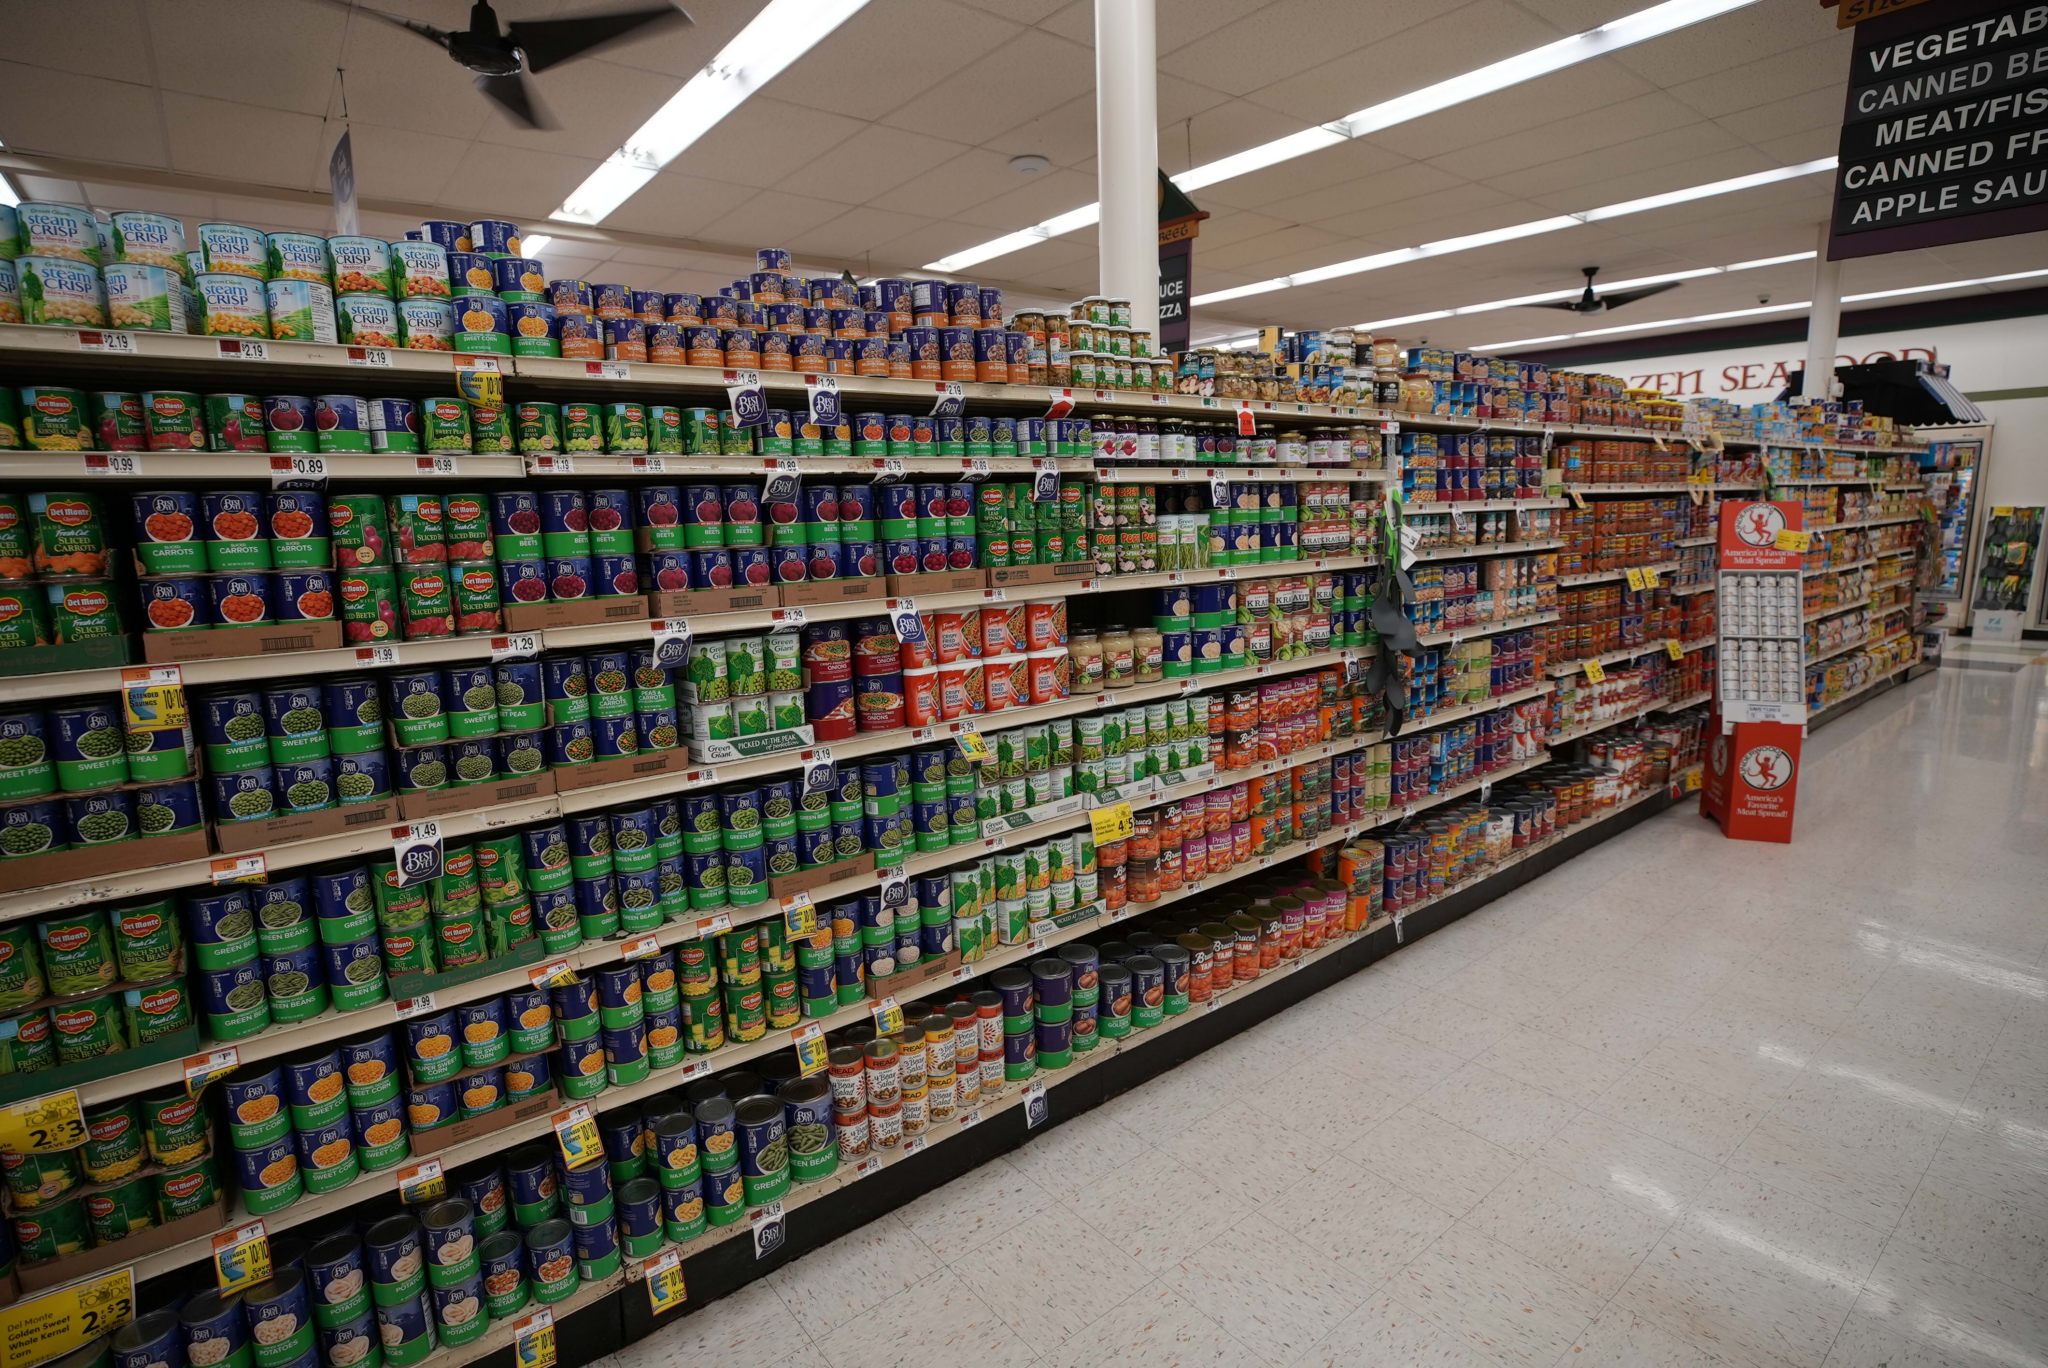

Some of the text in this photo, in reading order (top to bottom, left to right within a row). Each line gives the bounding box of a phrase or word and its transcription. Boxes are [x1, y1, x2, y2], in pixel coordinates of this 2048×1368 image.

[1858, 61, 1993, 113] CANNED
[1845, 141, 1993, 189] CANNED
[1851, 170, 2047, 224] APPLE SAU
[28, 213, 77, 228] steam
[30, 224, 78, 238] CRISP
[121, 221, 168, 234] steam
[124, 231, 168, 244] CRISP
[207, 233, 249, 246] steam
[209, 243, 249, 254] CRISP
[283, 253, 322, 264] CRISP
[104, 332, 128, 349] $2.19
[241, 343, 263, 357] $2.19
[367, 351, 386, 363] $2.19
[738, 373, 758, 385] $1.49
[818, 378, 835, 388] $1.29
[109, 458, 133, 472] $0.99
[293, 459, 322, 474] $0.89
[434, 458, 452, 472] $0.99
[553, 459, 569, 471] $1.19
[778, 460, 797, 472] $0.89
[885, 460, 901, 471] $0.79
[971, 460, 988, 471] $0.89
[58, 537, 91, 545] SLICED
[152, 548, 194, 557] CARROTS
[219, 546, 259, 554] CARROTS
[276, 544, 312, 553] CARROTS
[1755, 557, 1786, 565] Spread!
[431, 606, 448, 614] BEETS
[897, 600, 914, 610] $1.29
[75, 626, 107, 634] SLICED
[666, 621, 687, 633] $1.29
[509, 637, 534, 650] $1.29
[774, 644, 794, 652] Giant
[374, 648, 392, 661] $1.99
[599, 698, 627, 706] CARROTS
[404, 720, 444, 732] SWEET PEAS
[959, 722, 974, 732] $5.29
[282, 734, 325, 747] SWEET PEAS
[738, 741, 758, 750] PICKED
[769, 738, 779, 746] THE
[780, 733, 796, 743] PEAK
[708, 745, 731, 753] Green
[813, 749, 830, 760] $3.19
[1744, 794, 1783, 802] America's
[1747, 801, 1779, 810] Favorite
[1737, 808, 1788, 818] Meat Spread!
[410, 824, 436, 837] $1.49
[1118, 821, 1124, 831] 4
[615, 852, 652, 862] GREEN BEANS
[622, 910, 658, 921] GREEN BEANS
[260, 927, 308, 941] GREEN BEANS
[413, 996, 430, 1006] $1.99
[956, 1019, 977, 1029] READ
[902, 1044, 924, 1054] READ
[874, 1056, 896, 1068] READ
[428, 1067, 448, 1076] CORN
[104, 1118, 128, 1133] Monte
[238, 1117, 285, 1137] SWEET CORN
[29, 1130, 52, 1148] 2
[57, 1120, 84, 1137] $3
[42, 1142, 64, 1150] SAVE
[754, 1179, 782, 1191] GREEN
[763, 1202, 781, 1218] $4.19
[220, 1249, 246, 1263] EXTENDED
[221, 1257, 245, 1271] SAVINGS
[253, 1264, 270, 1274] Save
[441, 1258, 474, 1276] POTATOES
[251, 1269, 270, 1281] $3.90
[540, 1277, 576, 1295] VEGETABLES
[330, 1294, 365, 1315] POTATOES
[8, 1312, 54, 1332] Del Monte
[82, 1312, 100, 1335] 2
[108, 1299, 131, 1319] $3
[8, 1316, 70, 1341] Golden Sweet
[446, 1320, 480, 1336] POTATOES
[9, 1325, 70, 1350] Whole Kernel
[260, 1339, 298, 1356] POTATOES
[10, 1349, 31, 1360] Corn
